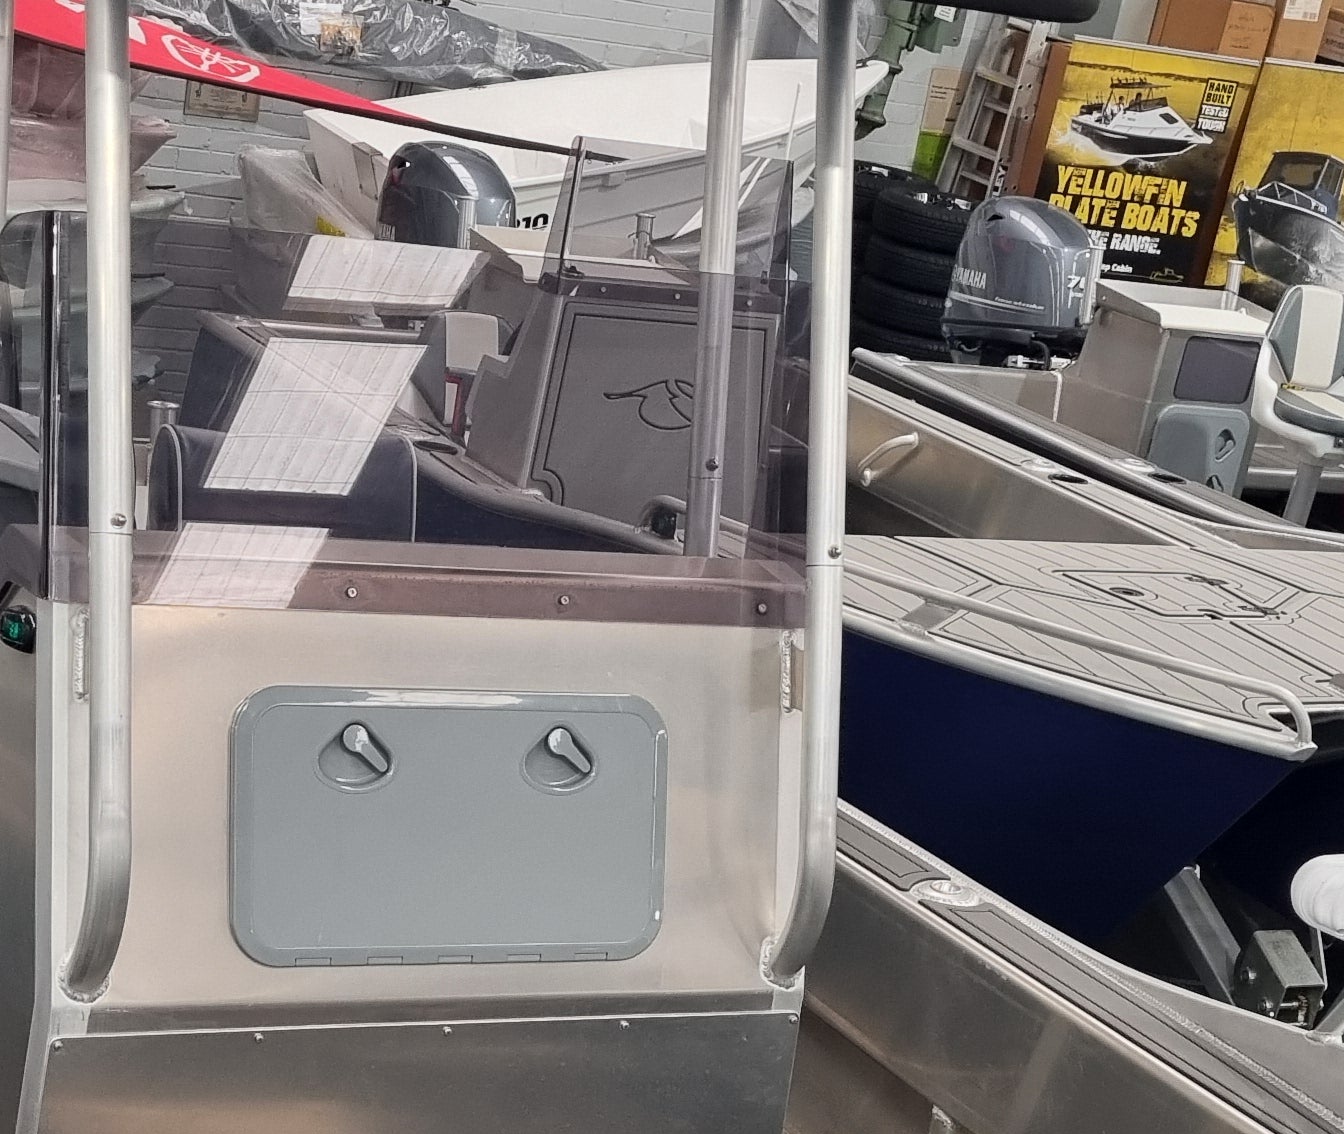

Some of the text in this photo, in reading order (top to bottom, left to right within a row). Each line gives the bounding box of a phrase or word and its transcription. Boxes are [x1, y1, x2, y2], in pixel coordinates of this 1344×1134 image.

[1208, 81, 1234, 95] HAND
[1205, 92, 1232, 105] BUILT
[1201, 104, 1230, 118] TESTED
[1056, 164, 1188, 207] YELLOWFIN
[516, 213, 549, 230] 10
[1120, 203, 1201, 238] BOATS
[1087, 229, 1110, 249] HE
[956, 266, 987, 290] YAMAHA
